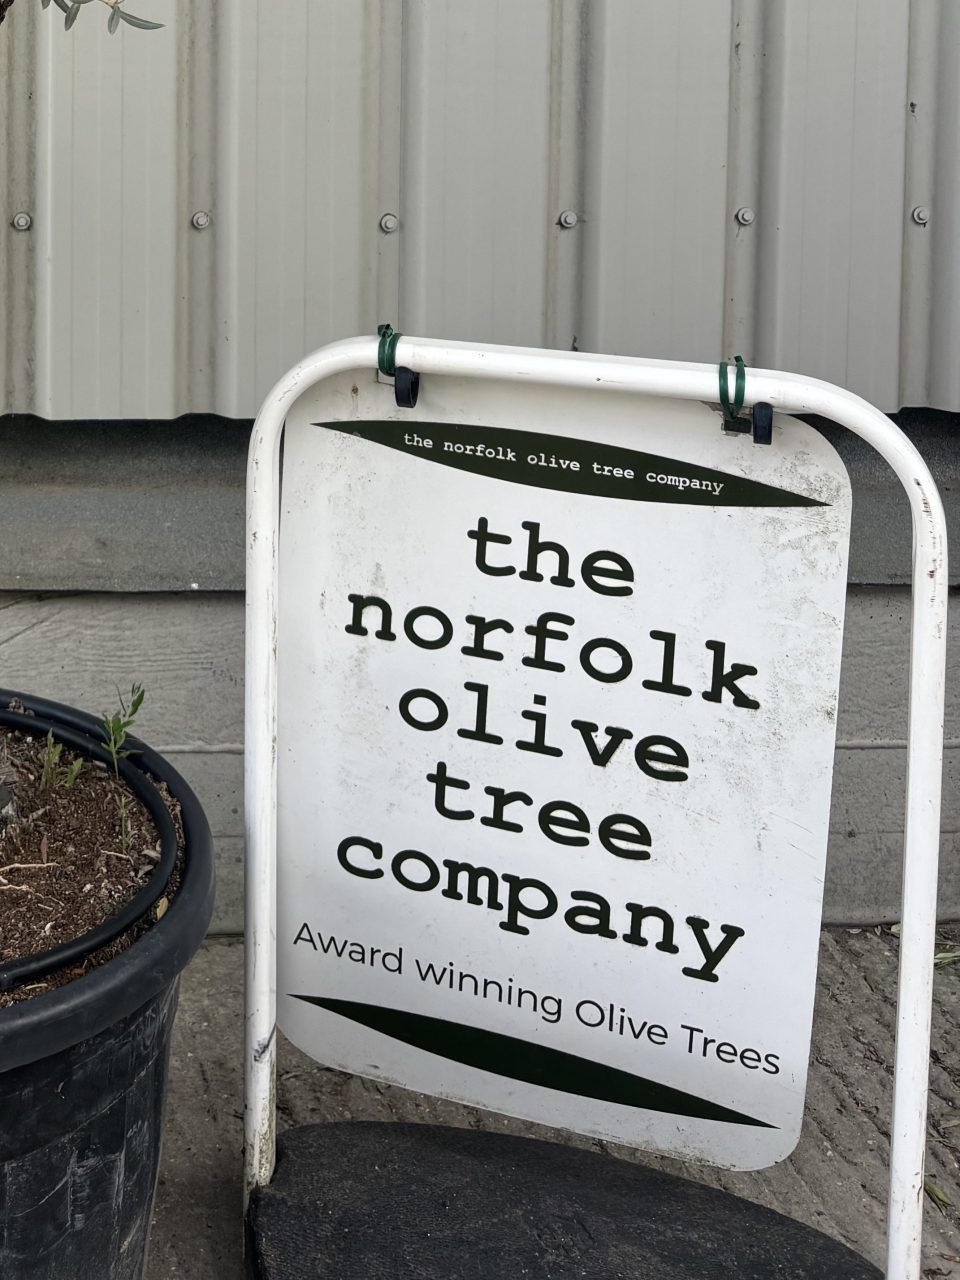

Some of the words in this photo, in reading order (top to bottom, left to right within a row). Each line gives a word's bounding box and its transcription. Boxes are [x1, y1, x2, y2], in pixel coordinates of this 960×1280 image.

[403, 432, 434, 449] the
[443, 440, 517, 462] norfolk
[527, 453, 581, 472] olive
[592, 461, 635, 480] tree
[645, 471, 725, 495] company
[467, 516, 635, 597] the
[344, 593, 761, 710] norfolk
[398, 681, 690, 783] olive
[426, 761, 653, 861] tree
[336, 835, 745, 983] company
[292, 922, 403, 975] Award
[415, 958, 563, 1024] winning
[575, 999, 669, 1046] Olive
[681, 1024, 781, 1075] Trees
